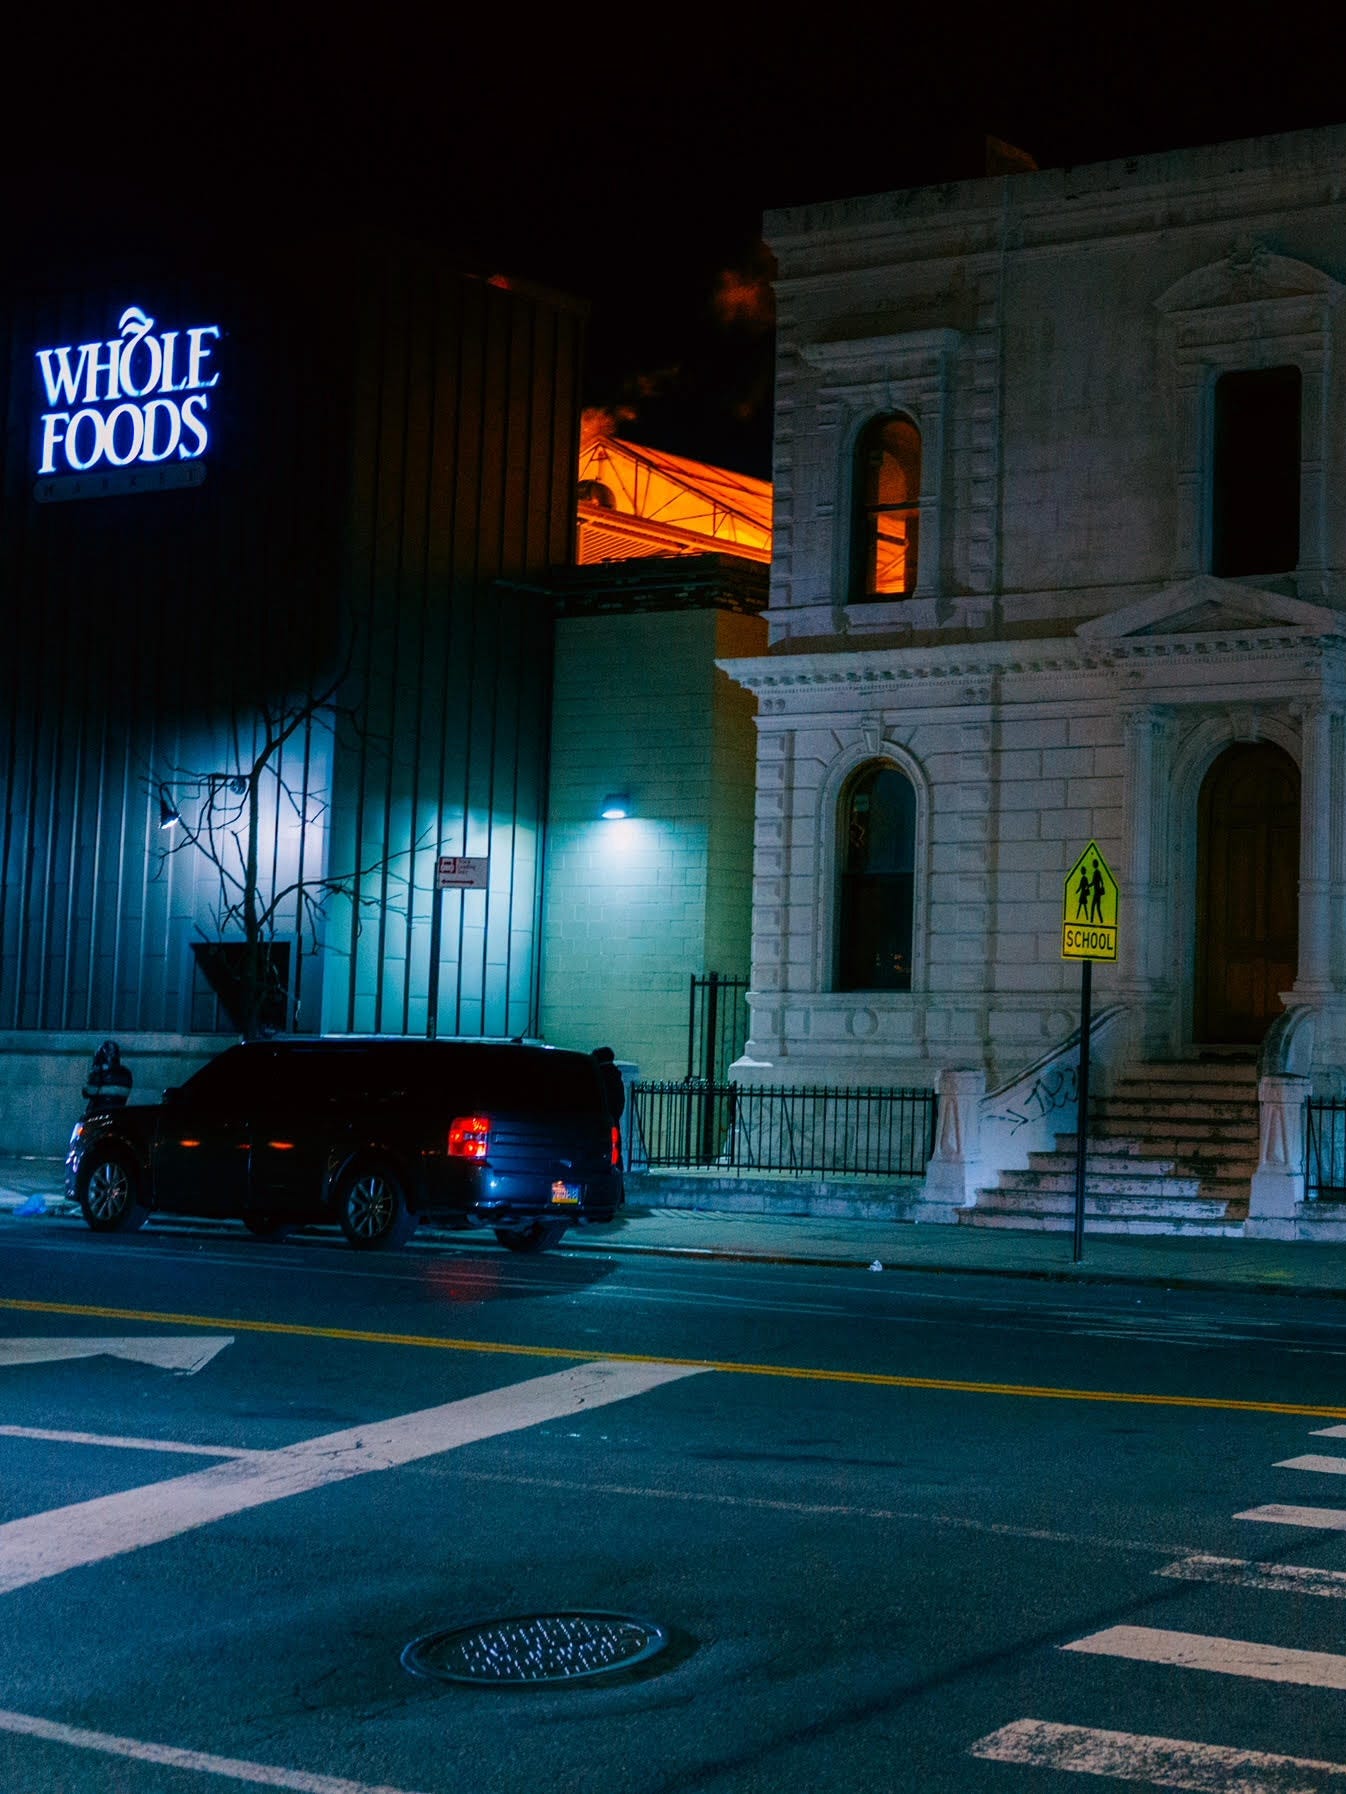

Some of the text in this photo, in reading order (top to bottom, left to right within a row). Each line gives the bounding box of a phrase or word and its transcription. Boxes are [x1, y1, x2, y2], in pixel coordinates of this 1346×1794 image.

[35, 306, 220, 407] WHOLE
[37, 393, 209, 474] FOODS
[1066, 930, 1113, 950] SCHOOL
